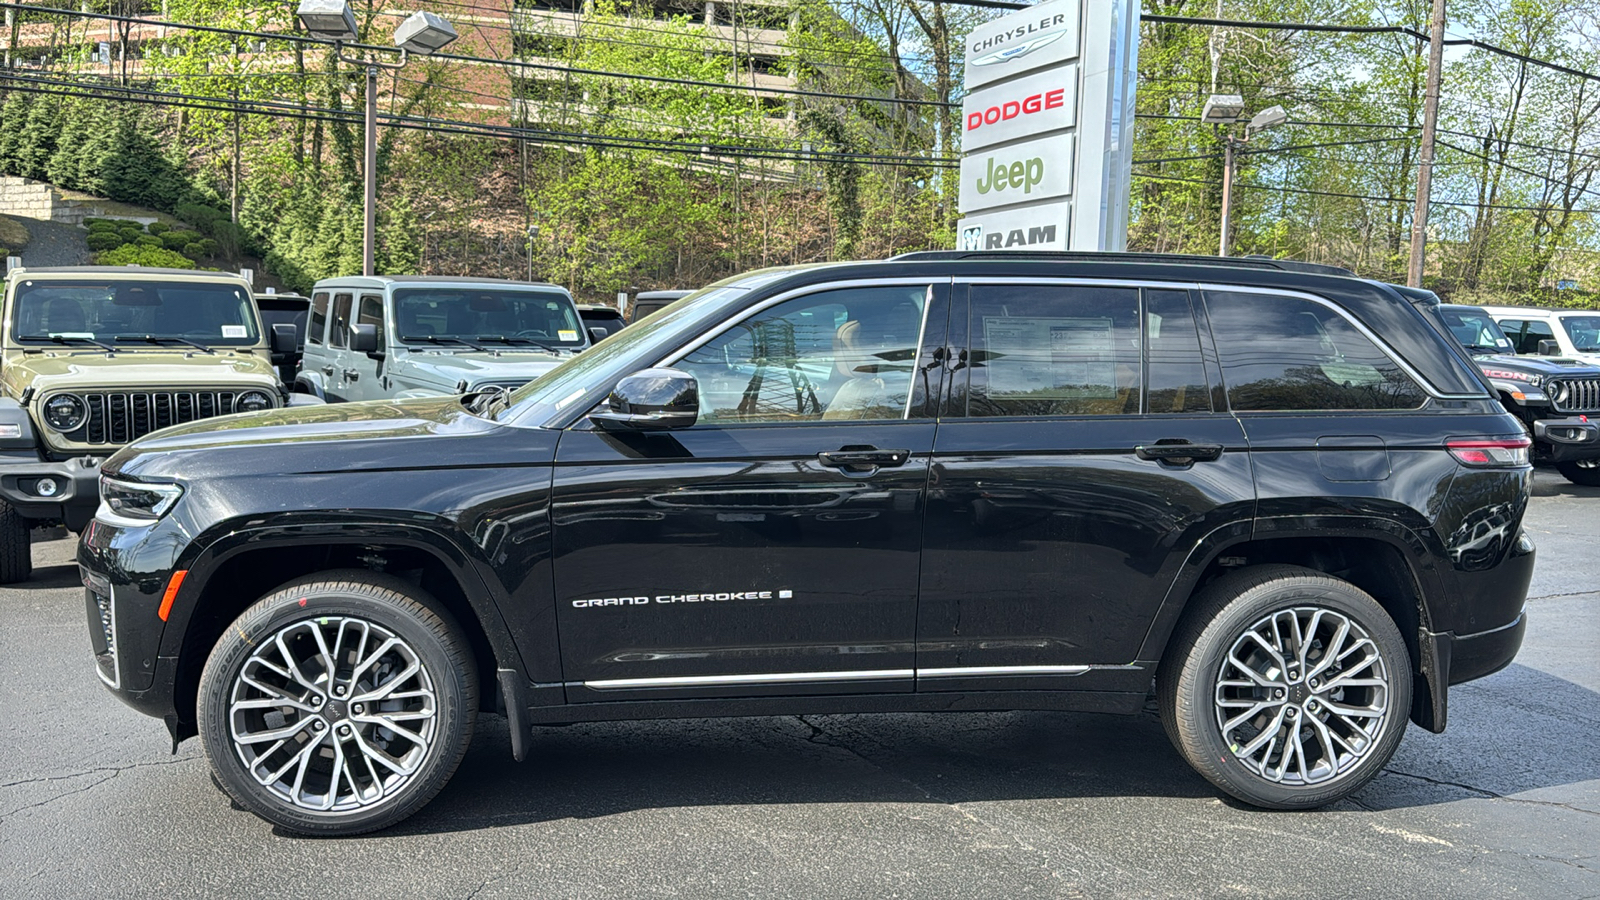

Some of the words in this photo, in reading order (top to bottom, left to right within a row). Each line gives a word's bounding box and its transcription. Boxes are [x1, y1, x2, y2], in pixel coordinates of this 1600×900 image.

[973, 13, 1065, 53] CHRYSLER
[967, 88, 1065, 131] DODGE
[976, 157, 1044, 195] Jeep
[985, 225, 1057, 250] RAM
[1482, 369, 1528, 380] ICON
[572, 596, 649, 608] GRAND
[655, 591, 773, 604] CHEROKEE
